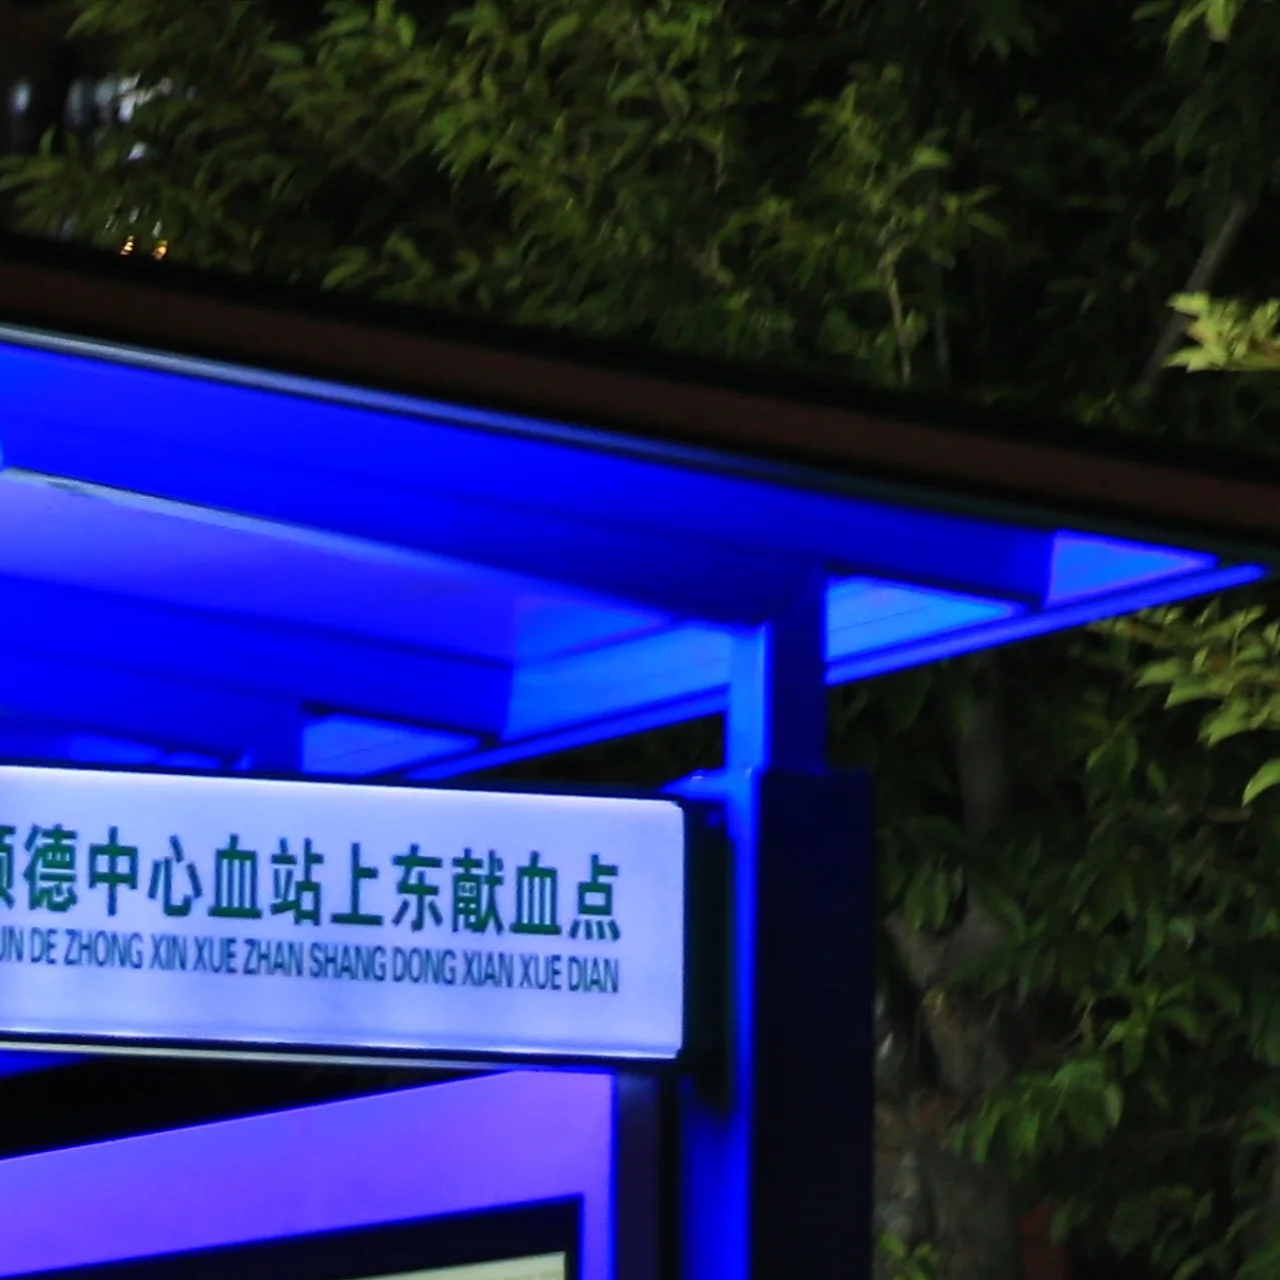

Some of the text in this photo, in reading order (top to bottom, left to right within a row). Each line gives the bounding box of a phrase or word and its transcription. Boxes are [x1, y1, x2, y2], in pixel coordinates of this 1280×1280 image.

[29, 927, 59, 965] DE
[63, 929, 144, 969] ZHONG
[149, 934, 189, 971] XIN
[192, 936, 238, 974] XUE
[242, 938, 304, 977] ZHAN
[309, 942, 387, 982] SHANG
[392, 947, 457, 985] DONG
[461, 951, 515, 989] XIAN
[518, 954, 562, 990] XUE
[567, 956, 620, 993] DIAN
